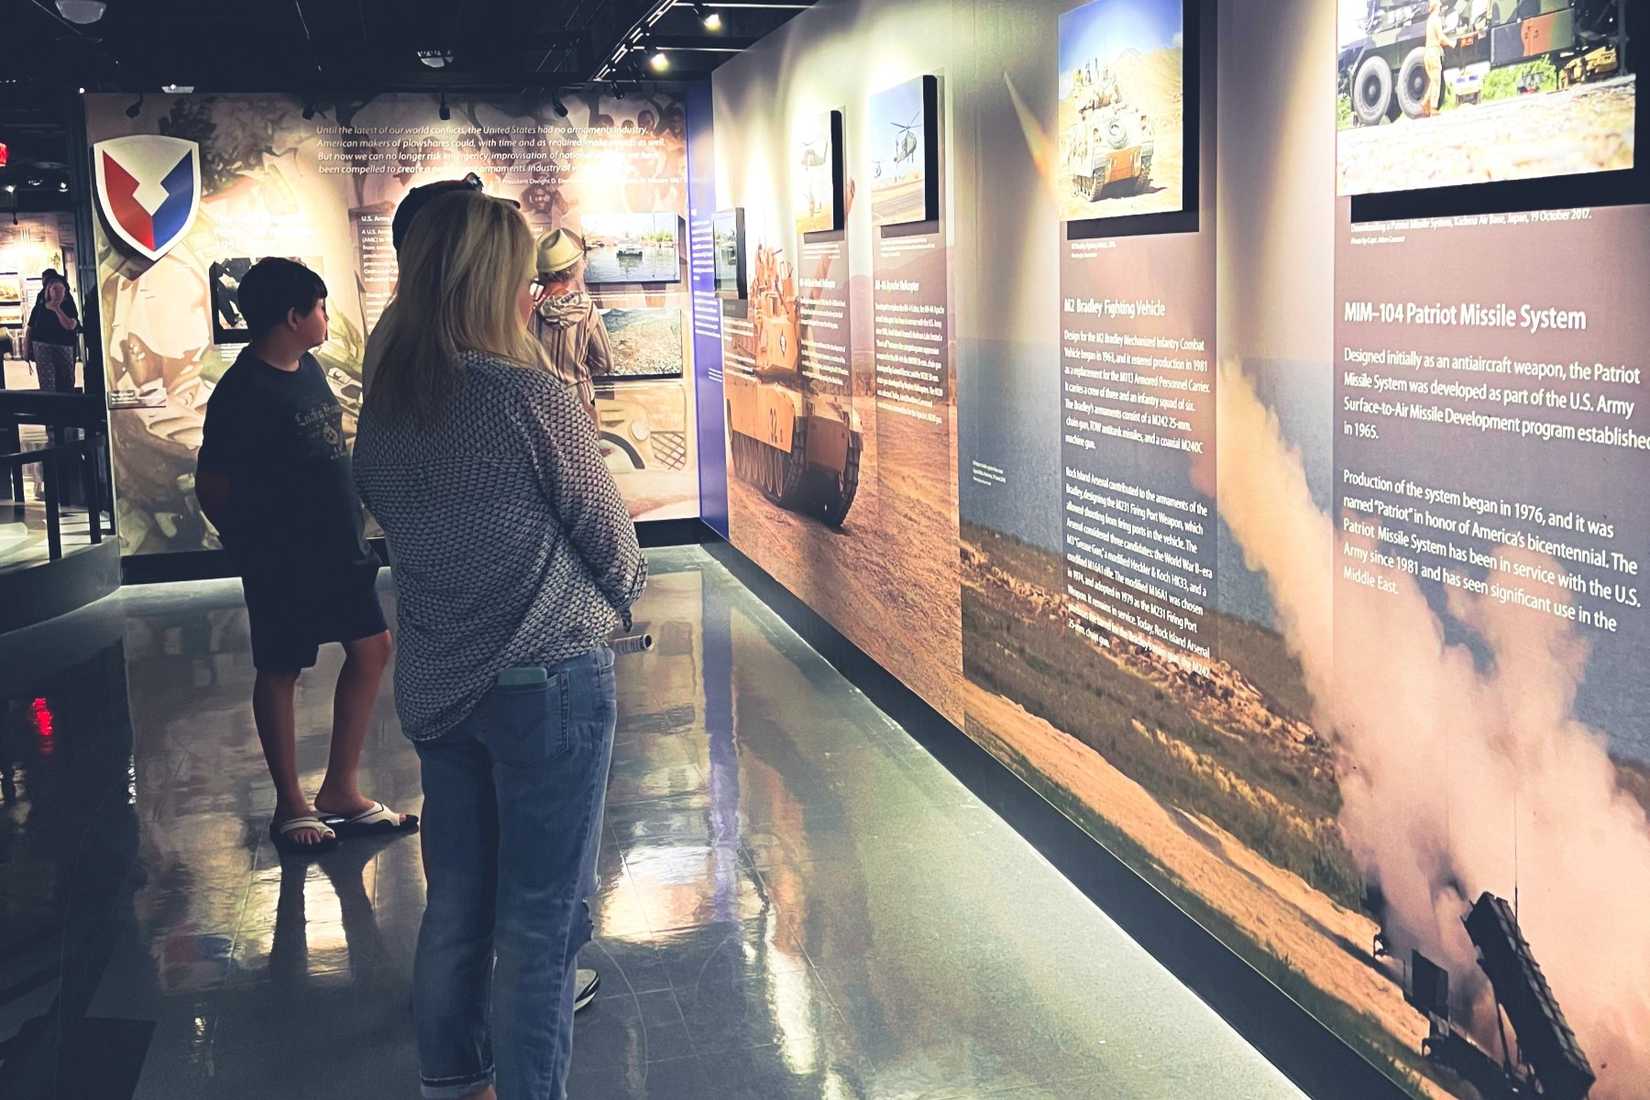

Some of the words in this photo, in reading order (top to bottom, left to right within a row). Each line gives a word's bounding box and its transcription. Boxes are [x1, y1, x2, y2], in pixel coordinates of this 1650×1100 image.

[320, 166, 339, 174] been
[341, 166, 386, 175] compelled
[398, 153, 426, 162] longer
[491, 152, 547, 161] improvisation
[1540, 208, 1569, 222] October
[1570, 207, 1592, 220] 2017.
[1077, 298, 1103, 317] Bradley
[1104, 299, 1136, 318] Fighting
[1136, 299, 1166, 317] Vehicle
[1344, 302, 1404, 323] MIM-104
[1407, 302, 1457, 325] Patriot
[1460, 303, 1516, 327] Missile
[1520, 304, 1586, 334] System
[1181, 338, 1205, 351] Combat
[1344, 347, 1386, 367] Designed
[1387, 349, 1422, 371] initially
[1423, 354, 1435, 367] as
[1436, 355, 1450, 369] an
[1452, 354, 1512, 374] antiaircraft
[1514, 360, 1566, 381] weapon,
[1569, 361, 1592, 381] the
[1594, 363, 1640, 384] Patriot
[1344, 371, 1373, 388] Missile
[1374, 374, 1408, 393] System
[1409, 381, 1429, 394] was
[1430, 379, 1487, 402] developed
[1489, 387, 1501, 401] as
[1503, 388, 1529, 406] part
[1530, 388, 1544, 407] of
[1545, 389, 1568, 409] the
[1570, 391, 1594, 412] U.S.
[1596, 394, 1635, 420] Army
[1344, 396, 1409, 419] Surface-to-Air
[1410, 403, 1444, 423] Missile
[1445, 407, 1521, 432] Development
[1522, 420, 1576, 441] program
[1344, 420, 1353, 435] in
[1355, 422, 1380, 440] 1965.
[1146, 489, 1156, 502] the
[1197, 502, 1208, 517] the
[1344, 469, 1393, 493] Production
[1394, 479, 1406, 495] of
[1406, 482, 1423, 499] the
[1425, 487, 1461, 505] system
[1462, 491, 1498, 515] began
[1500, 499, 1512, 517] in
[1515, 502, 1546, 526] 1976,
[1548, 511, 1573, 530] and
[1575, 514, 1586, 533] it
[1587, 519, 1614, 539] was
[1185, 539, 1198, 554] The
[1344, 495, 1374, 513] named
[1414, 508, 1423, 524] in
[1425, 510, 1457, 532] honor
[1458, 519, 1471, 536] of
[1472, 521, 1525, 549] America's
[1527, 532, 1609, 569] bicentennial.
[1611, 551, 1639, 575] The
[1164, 552, 1182, 568] World
[1343, 517, 1376, 539] Patriot
[1377, 525, 1410, 547] Missile
[1411, 533, 1447, 557] System
[1448, 542, 1468, 563] has
[1469, 547, 1498, 570] been
[1500, 555, 1511, 574] in
[1513, 561, 1556, 585] service
[1557, 572, 1587, 594] with
[1589, 578, 1613, 601] the
[1615, 584, 1642, 609] U.S.
[1344, 565, 1376, 587] Middle
[1377, 574, 1399, 595] East.
[1344, 541, 1369, 565] Army
[1370, 549, 1395, 569] since
[1397, 556, 1419, 576] 1981
[1421, 564, 1441, 583] and
[1443, 567, 1461, 588] has
[1463, 576, 1488, 595] seen
[1490, 582, 1552, 614] significant
[1553, 602, 1577, 621] use
[1578, 605, 1592, 626] in
[1593, 610, 1618, 633] the
[1154, 624, 1169, 641] Rock
[1169, 630, 1187, 649] Island
[1187, 639, 1210, 661] Arsenal
